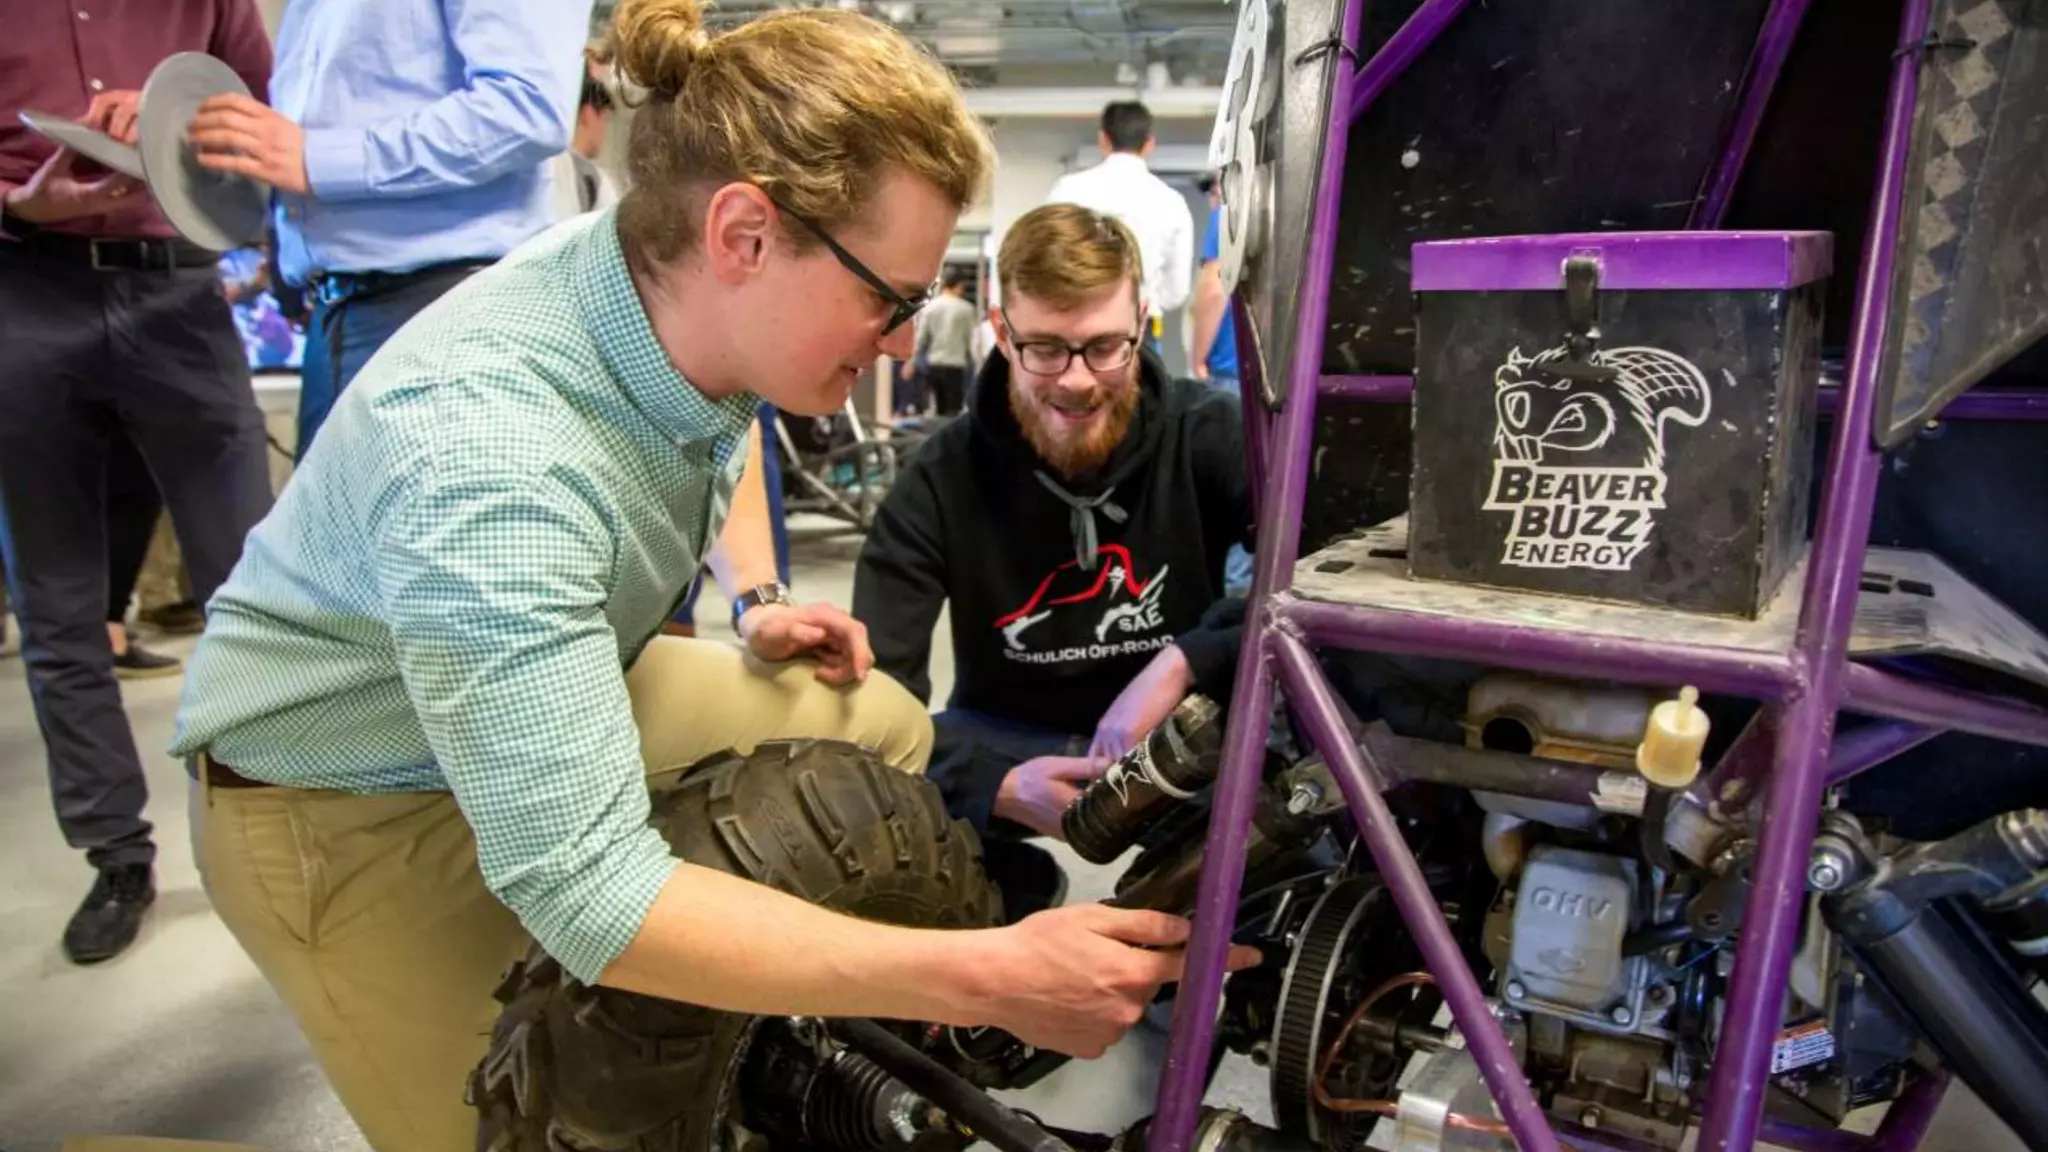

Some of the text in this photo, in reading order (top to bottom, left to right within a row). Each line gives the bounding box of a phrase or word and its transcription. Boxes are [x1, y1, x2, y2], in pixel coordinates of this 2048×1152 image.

[1494, 465, 1658, 503] BEAVER
[1516, 504, 1641, 542] BUZZ
[1509, 541, 1637, 566] ENERGY
[1118, 602, 1164, 633] SAE
[1003, 648, 1087, 664] SCHULICH
[1531, 886, 1612, 920] OHV
